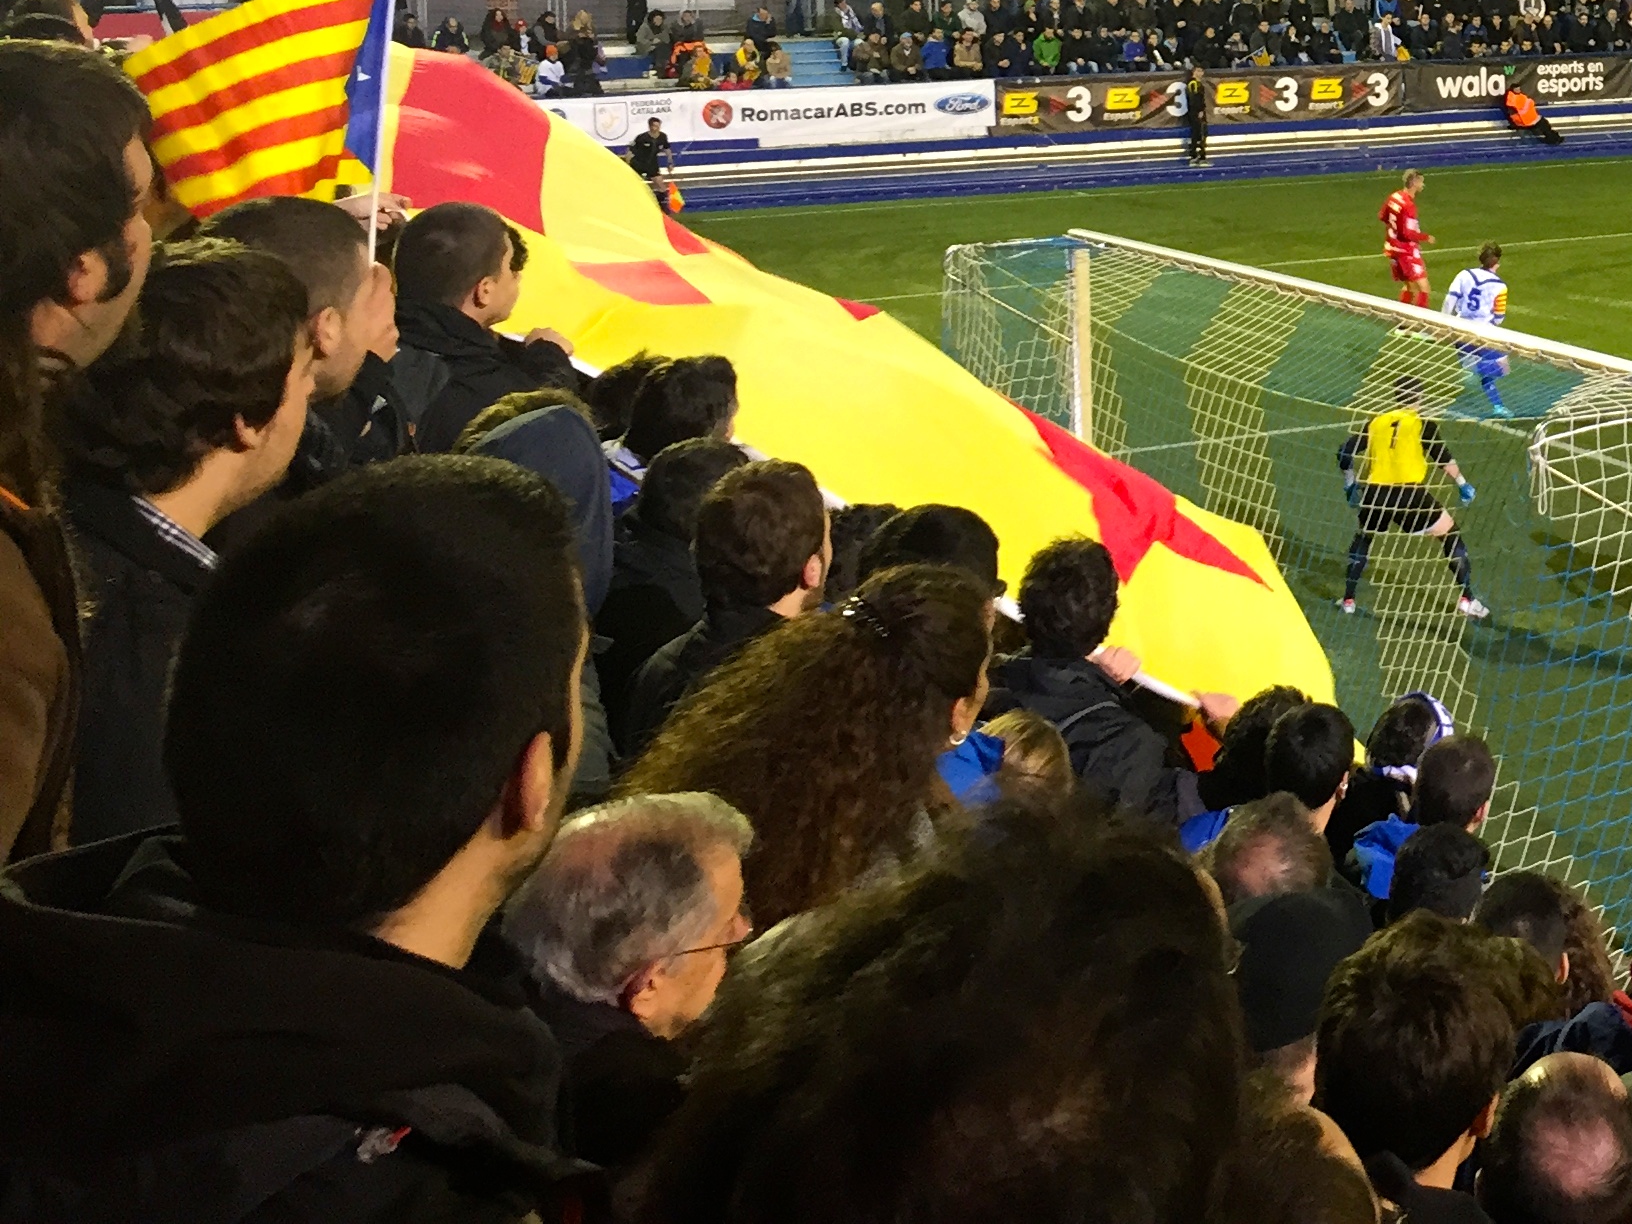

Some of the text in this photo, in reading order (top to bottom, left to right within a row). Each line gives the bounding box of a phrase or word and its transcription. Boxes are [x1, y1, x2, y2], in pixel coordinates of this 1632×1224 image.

[1536, 60, 1604, 78] experts en
[1274, 76, 1299, 112] 3
[1366, 72, 1389, 107] 3
[1436, 66, 1506, 99] wala
[1537, 73, 1604, 97] esports
[630, 106, 672, 115] CATALANA
[945, 95, 981, 113] Ford
[1066, 86, 1092, 122] 3
[1166, 81, 1189, 117] 3
[741, 101, 926, 122] RomacarABS.com
[1467, 287, 1482, 311] 5
